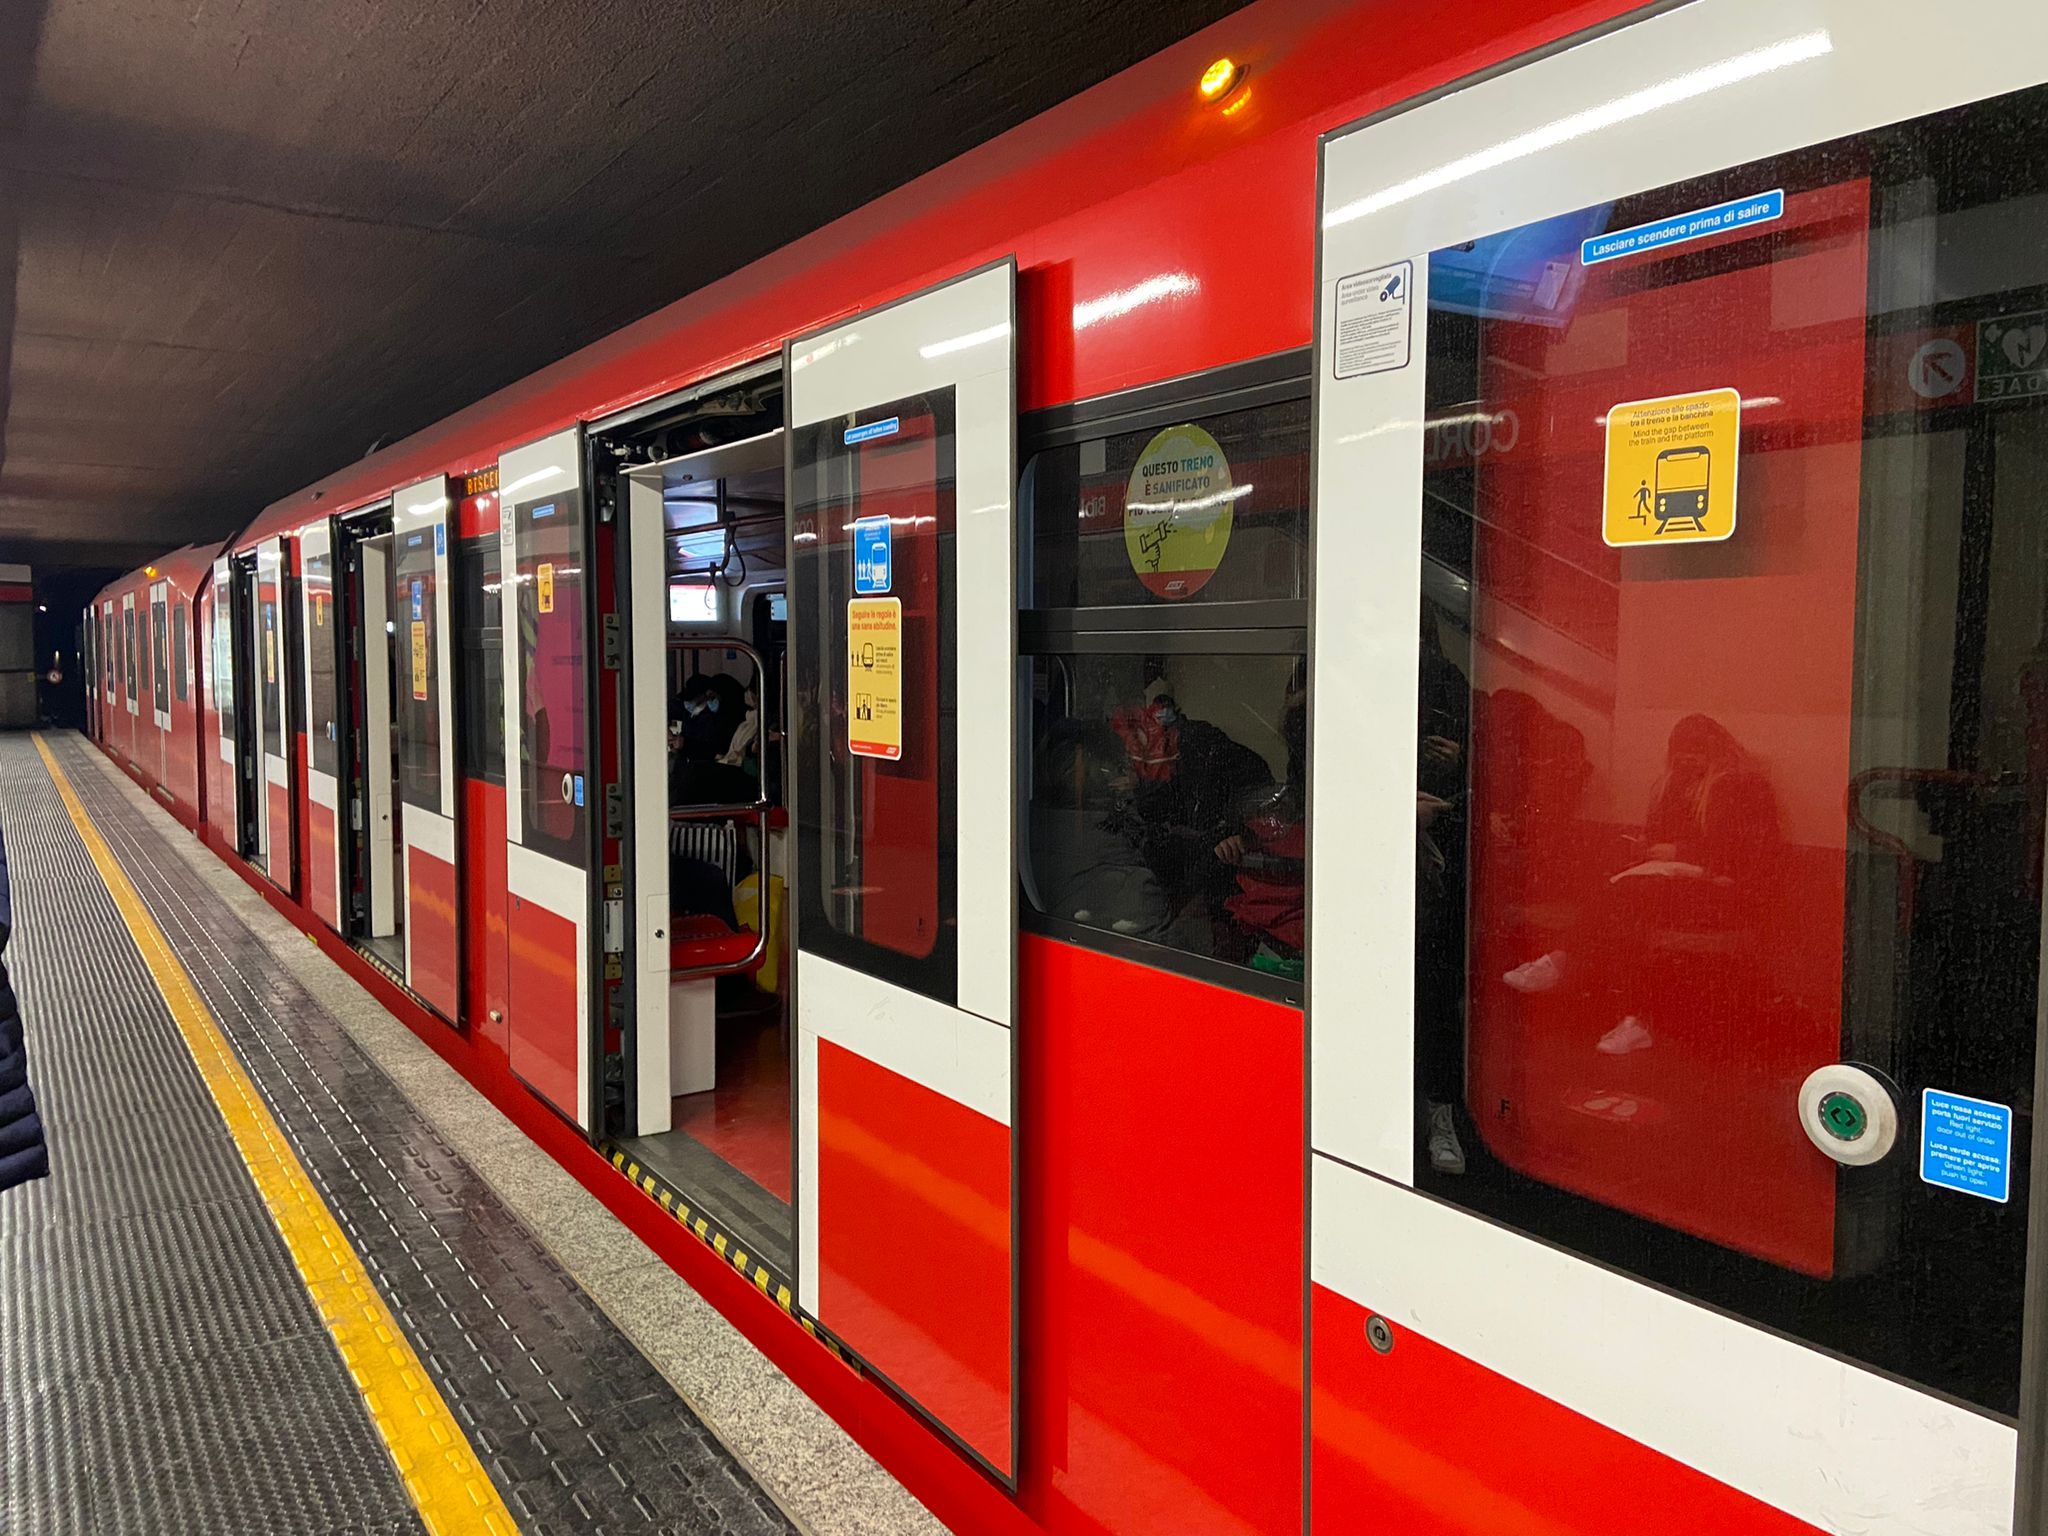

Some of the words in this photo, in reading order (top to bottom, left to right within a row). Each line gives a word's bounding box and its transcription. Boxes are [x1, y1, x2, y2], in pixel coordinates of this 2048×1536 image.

[1592, 237, 1635, 257] Lasciare
[1637, 225, 1687, 246] scendere
[1689, 215, 1721, 235] prima
[1723, 210, 1735, 223] di
[1737, 202, 1770, 220] salire
[1630, 419, 1640, 427] tra
[1640, 418, 1645, 426] il
[1646, 416, 1665, 426] treno
[1672, 414, 1679, 422] la
[1680, 410, 1714, 421] banchina
[1632, 407, 1670, 418] Attenzione
[1628, 438, 1639, 446] the
[1640, 436, 1656, 445] train
[1657, 434, 1670, 443] and
[1671, 432, 1682, 441] the
[1684, 430, 1714, 441] platform
[1633, 428, 1650, 438] Mind
[1651, 426, 1662, 435] the
[1663, 426, 1677, 436] gap
[1678, 422, 1709, 432] between
[1142, 460, 1179, 478] QUESTO
[1180, 455, 1214, 472] TRENO
[1145, 480, 1151, 496] È
[1153, 476, 1210, 495] SANIFICATO
[852, 610, 870, 620] Seguire
[876, 610, 892, 620] regole
[1931, 1099, 1950, 1109] Luce
[1951, 1104, 1972, 1114] rossa
[1973, 1109, 2003, 1121] accesa:
[1931, 1108, 1952, 1118] porta
[1953, 1112, 1971, 1122] fuori
[1972, 1117, 2003, 1130] servizio
[1949, 1119, 1964, 1129] Red
[1936, 1126, 1953, 1135] door
[1954, 1130, 1966, 1138] out
[1976, 1135, 1995, 1145] order
[1929, 1140, 1948, 1151] Luce
[1949, 1146, 1971, 1157] verde
[1930, 1150, 1961, 1163] premere
[1962, 1158, 1975, 1166] per
[1977, 1162, 2001, 1173] aprire
[1943, 1161, 1966, 1172] Green
[1941, 1169, 1959, 1179] push
[1960, 1173, 1968, 1181] to
[1969, 1176, 1988, 1186] open
